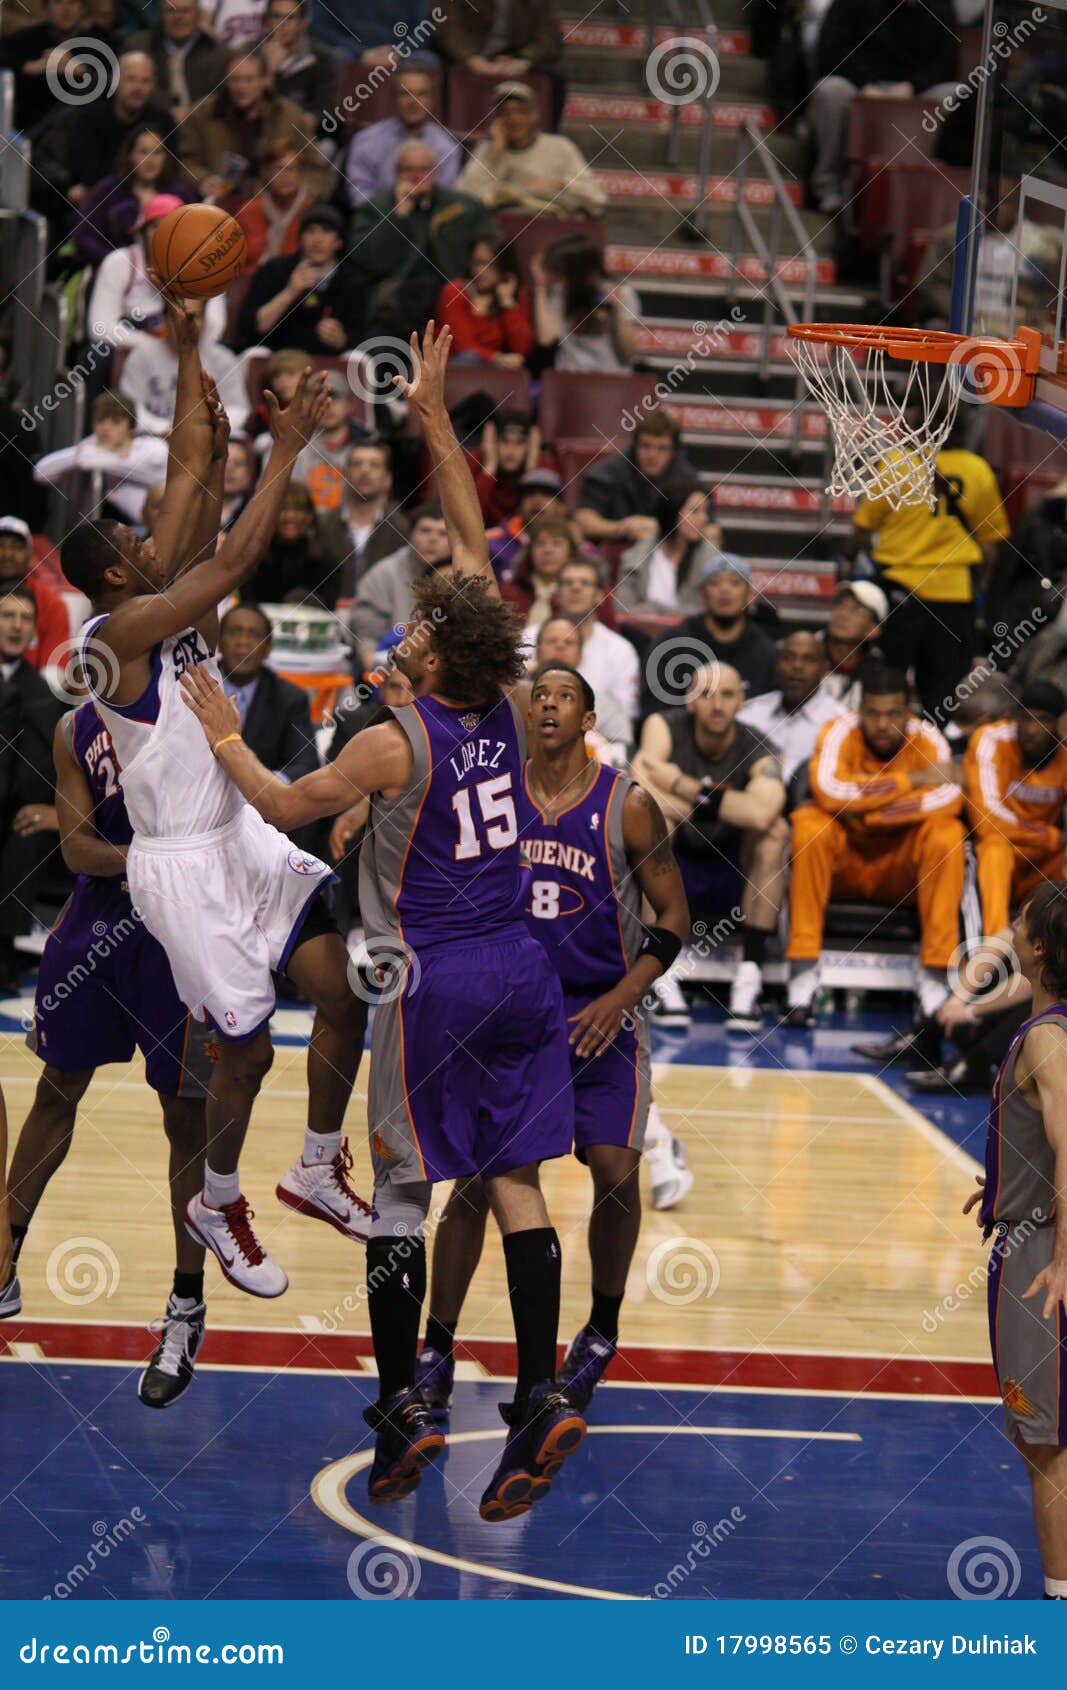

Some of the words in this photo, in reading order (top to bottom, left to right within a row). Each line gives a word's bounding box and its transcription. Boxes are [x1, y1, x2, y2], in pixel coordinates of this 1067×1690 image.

[97, 756, 121, 797] 2
[450, 738, 506, 781] LOPEZ
[451, 771, 518, 860] 15
[519, 838, 596, 883] HOENIX
[531, 879, 560, 919] 8
